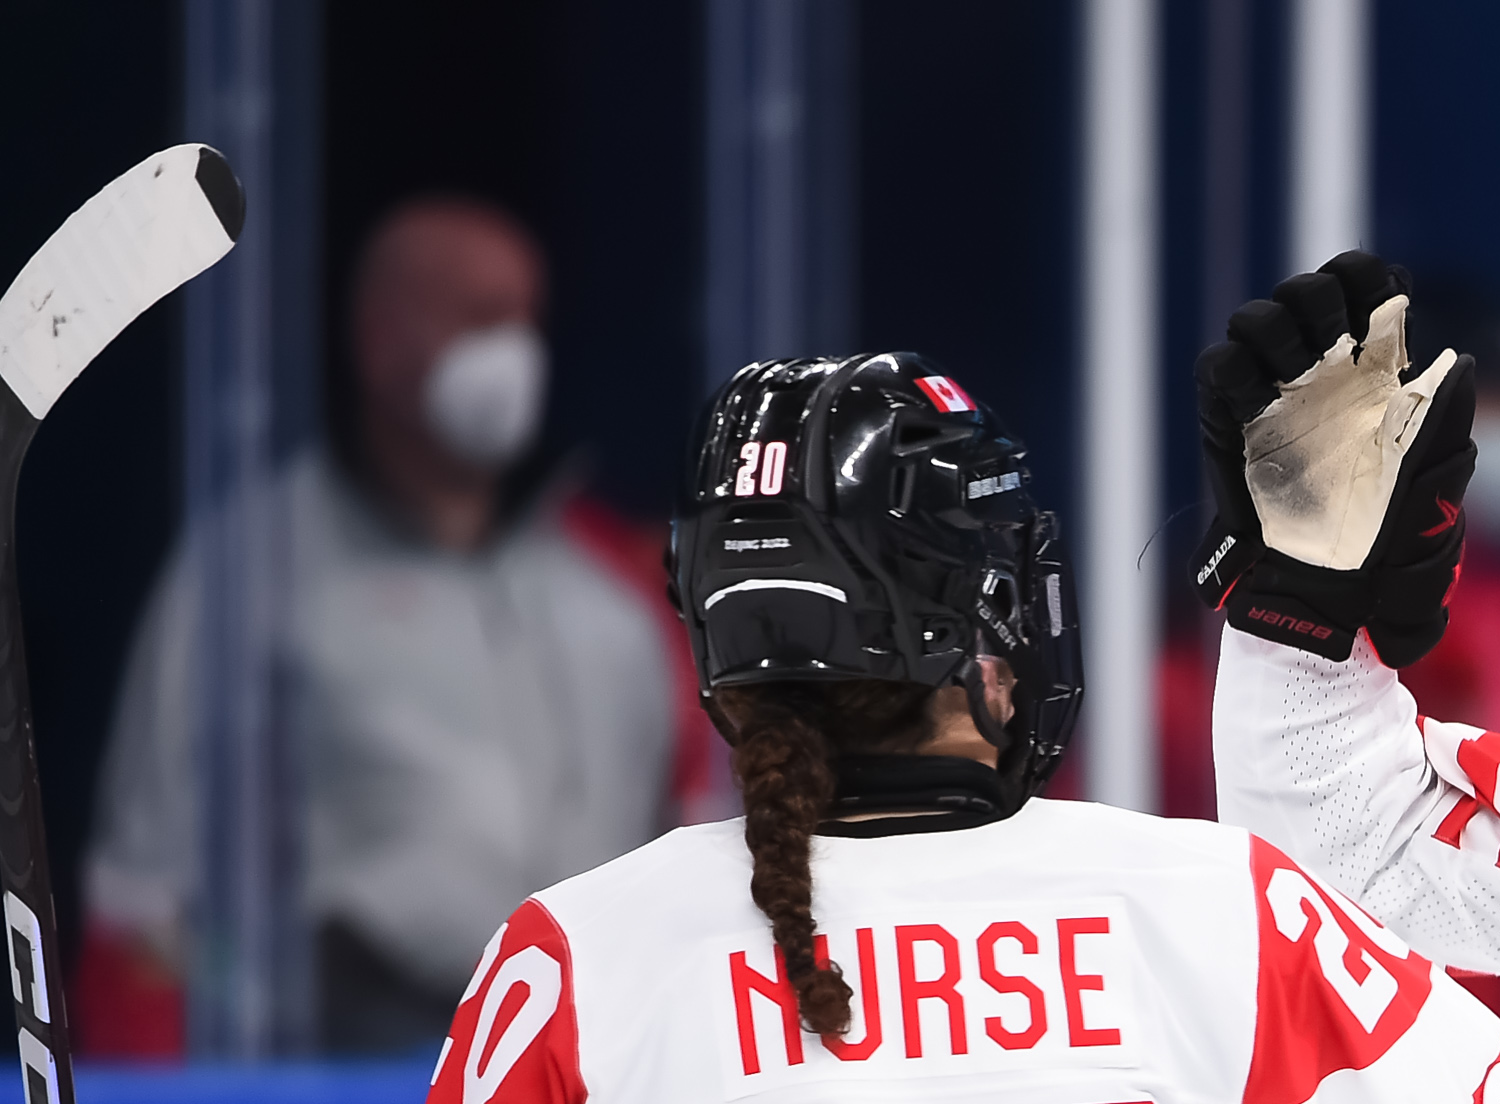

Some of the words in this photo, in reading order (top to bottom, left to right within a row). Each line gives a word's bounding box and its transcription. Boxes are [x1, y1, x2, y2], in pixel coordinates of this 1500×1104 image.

[734, 440, 788, 497] 20
[1197, 534, 1237, 585] CANADA
[1248, 606, 1333, 640] BAUER
[728, 916, 1123, 1076] NURSE
